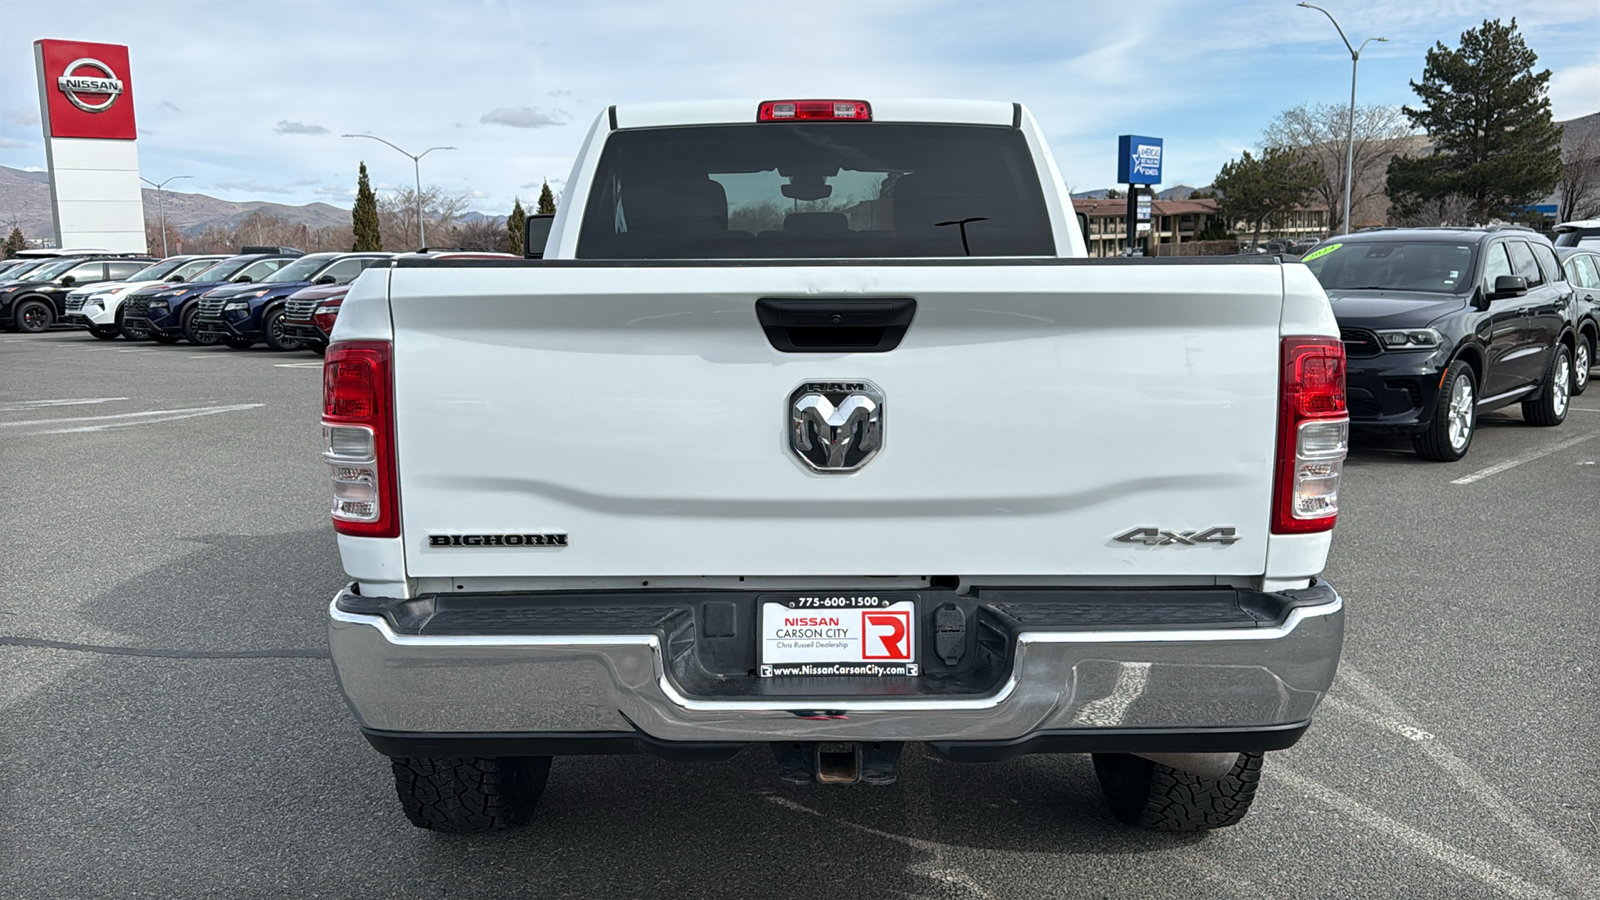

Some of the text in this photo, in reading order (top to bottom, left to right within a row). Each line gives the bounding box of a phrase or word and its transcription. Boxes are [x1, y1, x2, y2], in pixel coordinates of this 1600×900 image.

[66, 79, 118, 91] NISSAN
[807, 383, 864, 391] RAM
[428, 533, 568, 547] BIGHORN
[798, 597, 879, 607] 775-600-1500
[784, 617, 840, 627] NISSAN
[775, 628, 849, 638] CARSON CITY
[866, 615, 907, 659] R
[815, 641, 849, 649] Dealership
[773, 664, 906, 677] www.NissanCarsonCity.com
